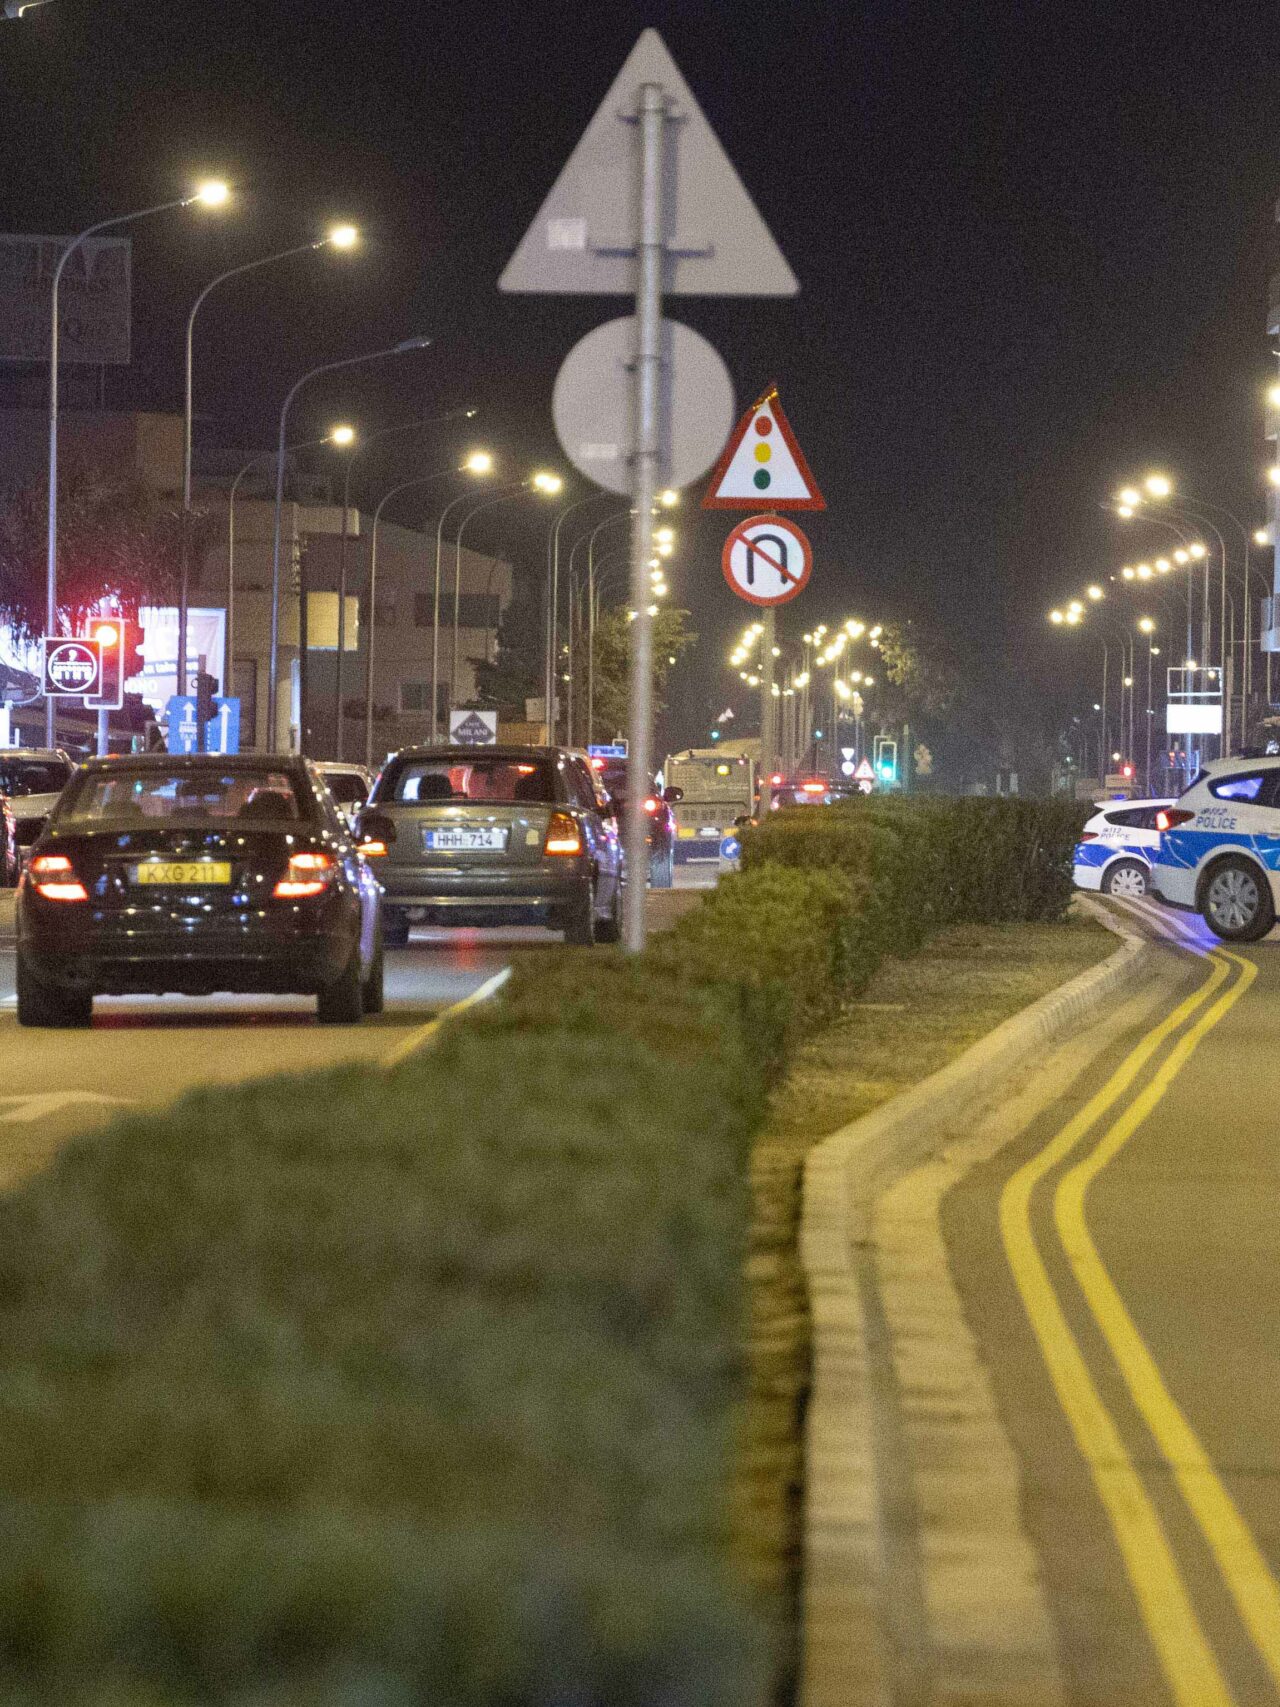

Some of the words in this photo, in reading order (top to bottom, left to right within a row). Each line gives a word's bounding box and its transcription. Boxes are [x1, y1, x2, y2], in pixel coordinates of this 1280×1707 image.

[1196, 816, 1238, 830] POLICE
[437, 834, 463, 847] HHH
[469, 833, 493, 847] 714
[147, 865, 185, 882] KXG
[189, 865, 215, 882] 211
